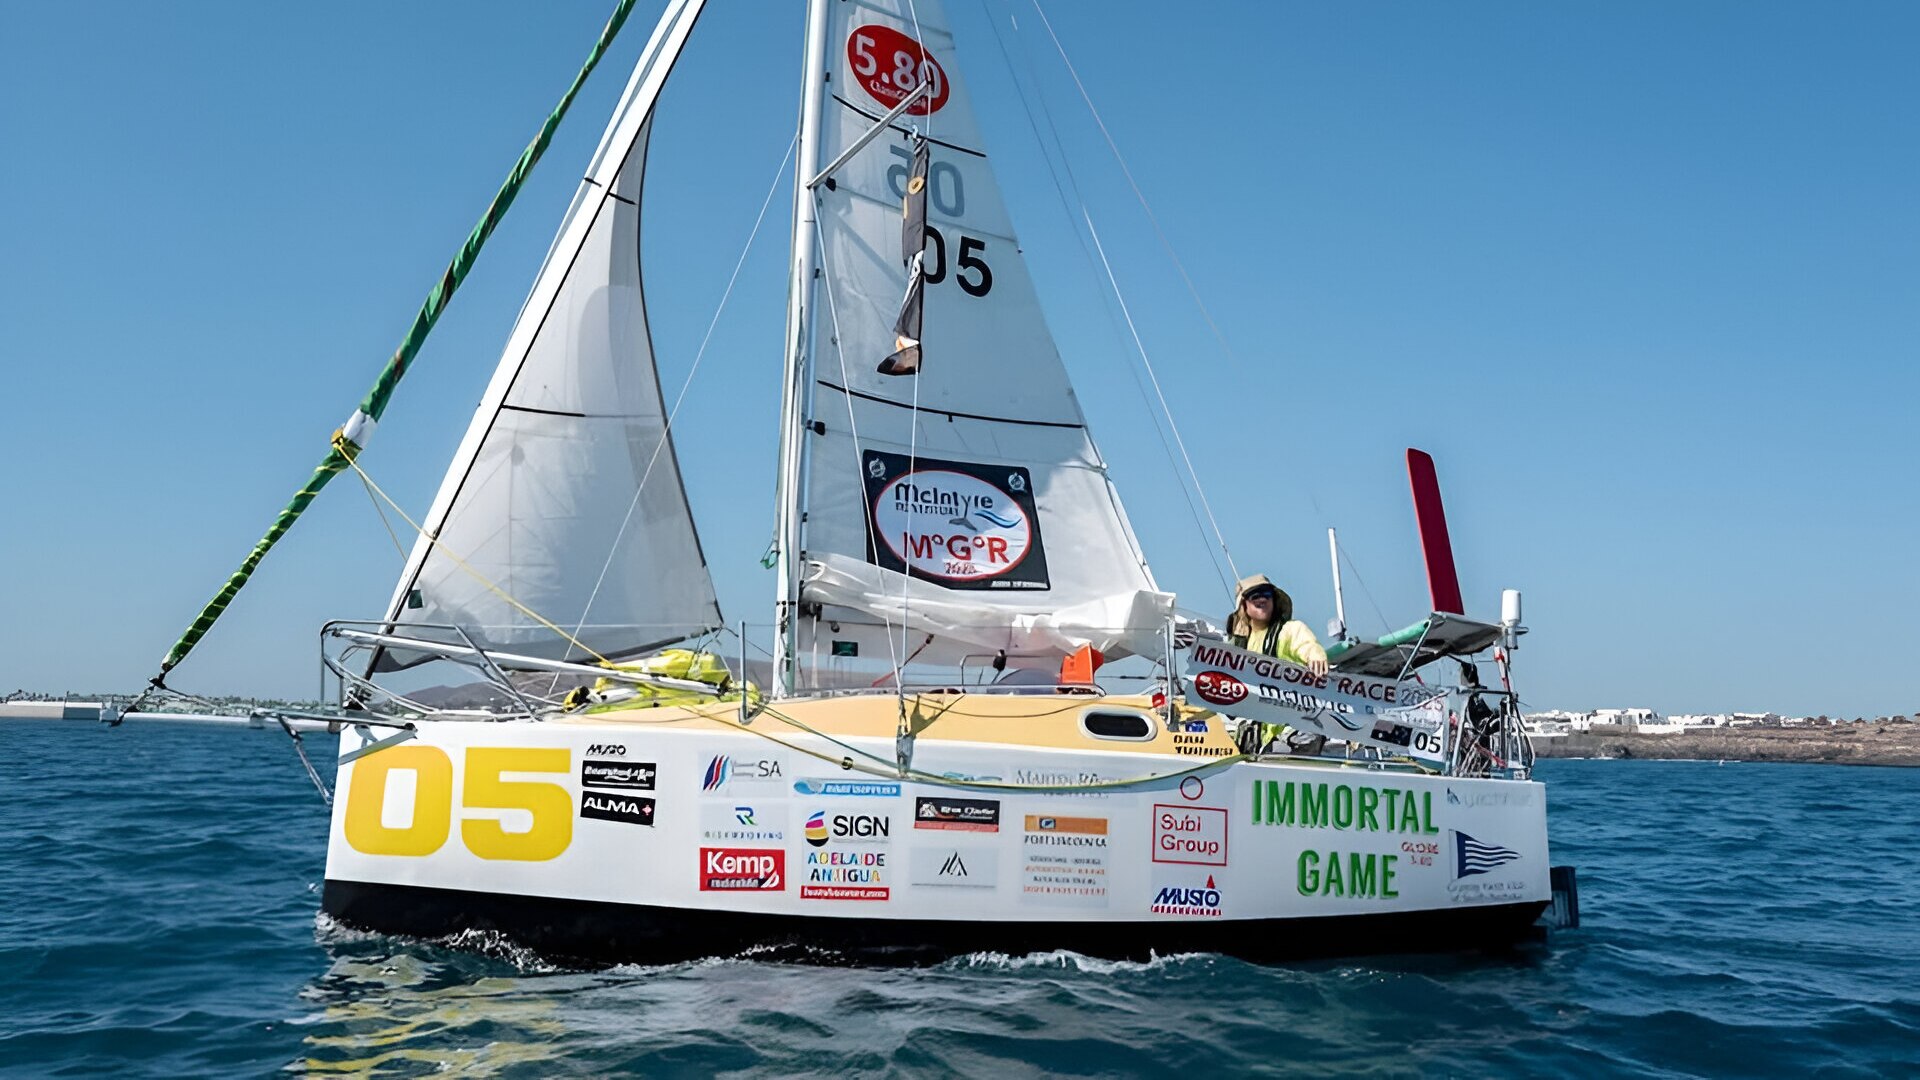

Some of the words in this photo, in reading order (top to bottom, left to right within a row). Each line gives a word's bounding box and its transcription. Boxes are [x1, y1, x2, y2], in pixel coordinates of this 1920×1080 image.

[1337, 676, 1396, 703] RACE
[1414, 731, 1441, 754] 05
[344, 745, 573, 862] 05
[583, 796, 640, 815] ALMA
[1252, 779, 1439, 834] IMMORTAL
[832, 815, 889, 838] SIGN
[1161, 834, 1219, 856] Group
[706, 851, 775, 879] Kemp
[1297, 849, 1399, 899] GAME
